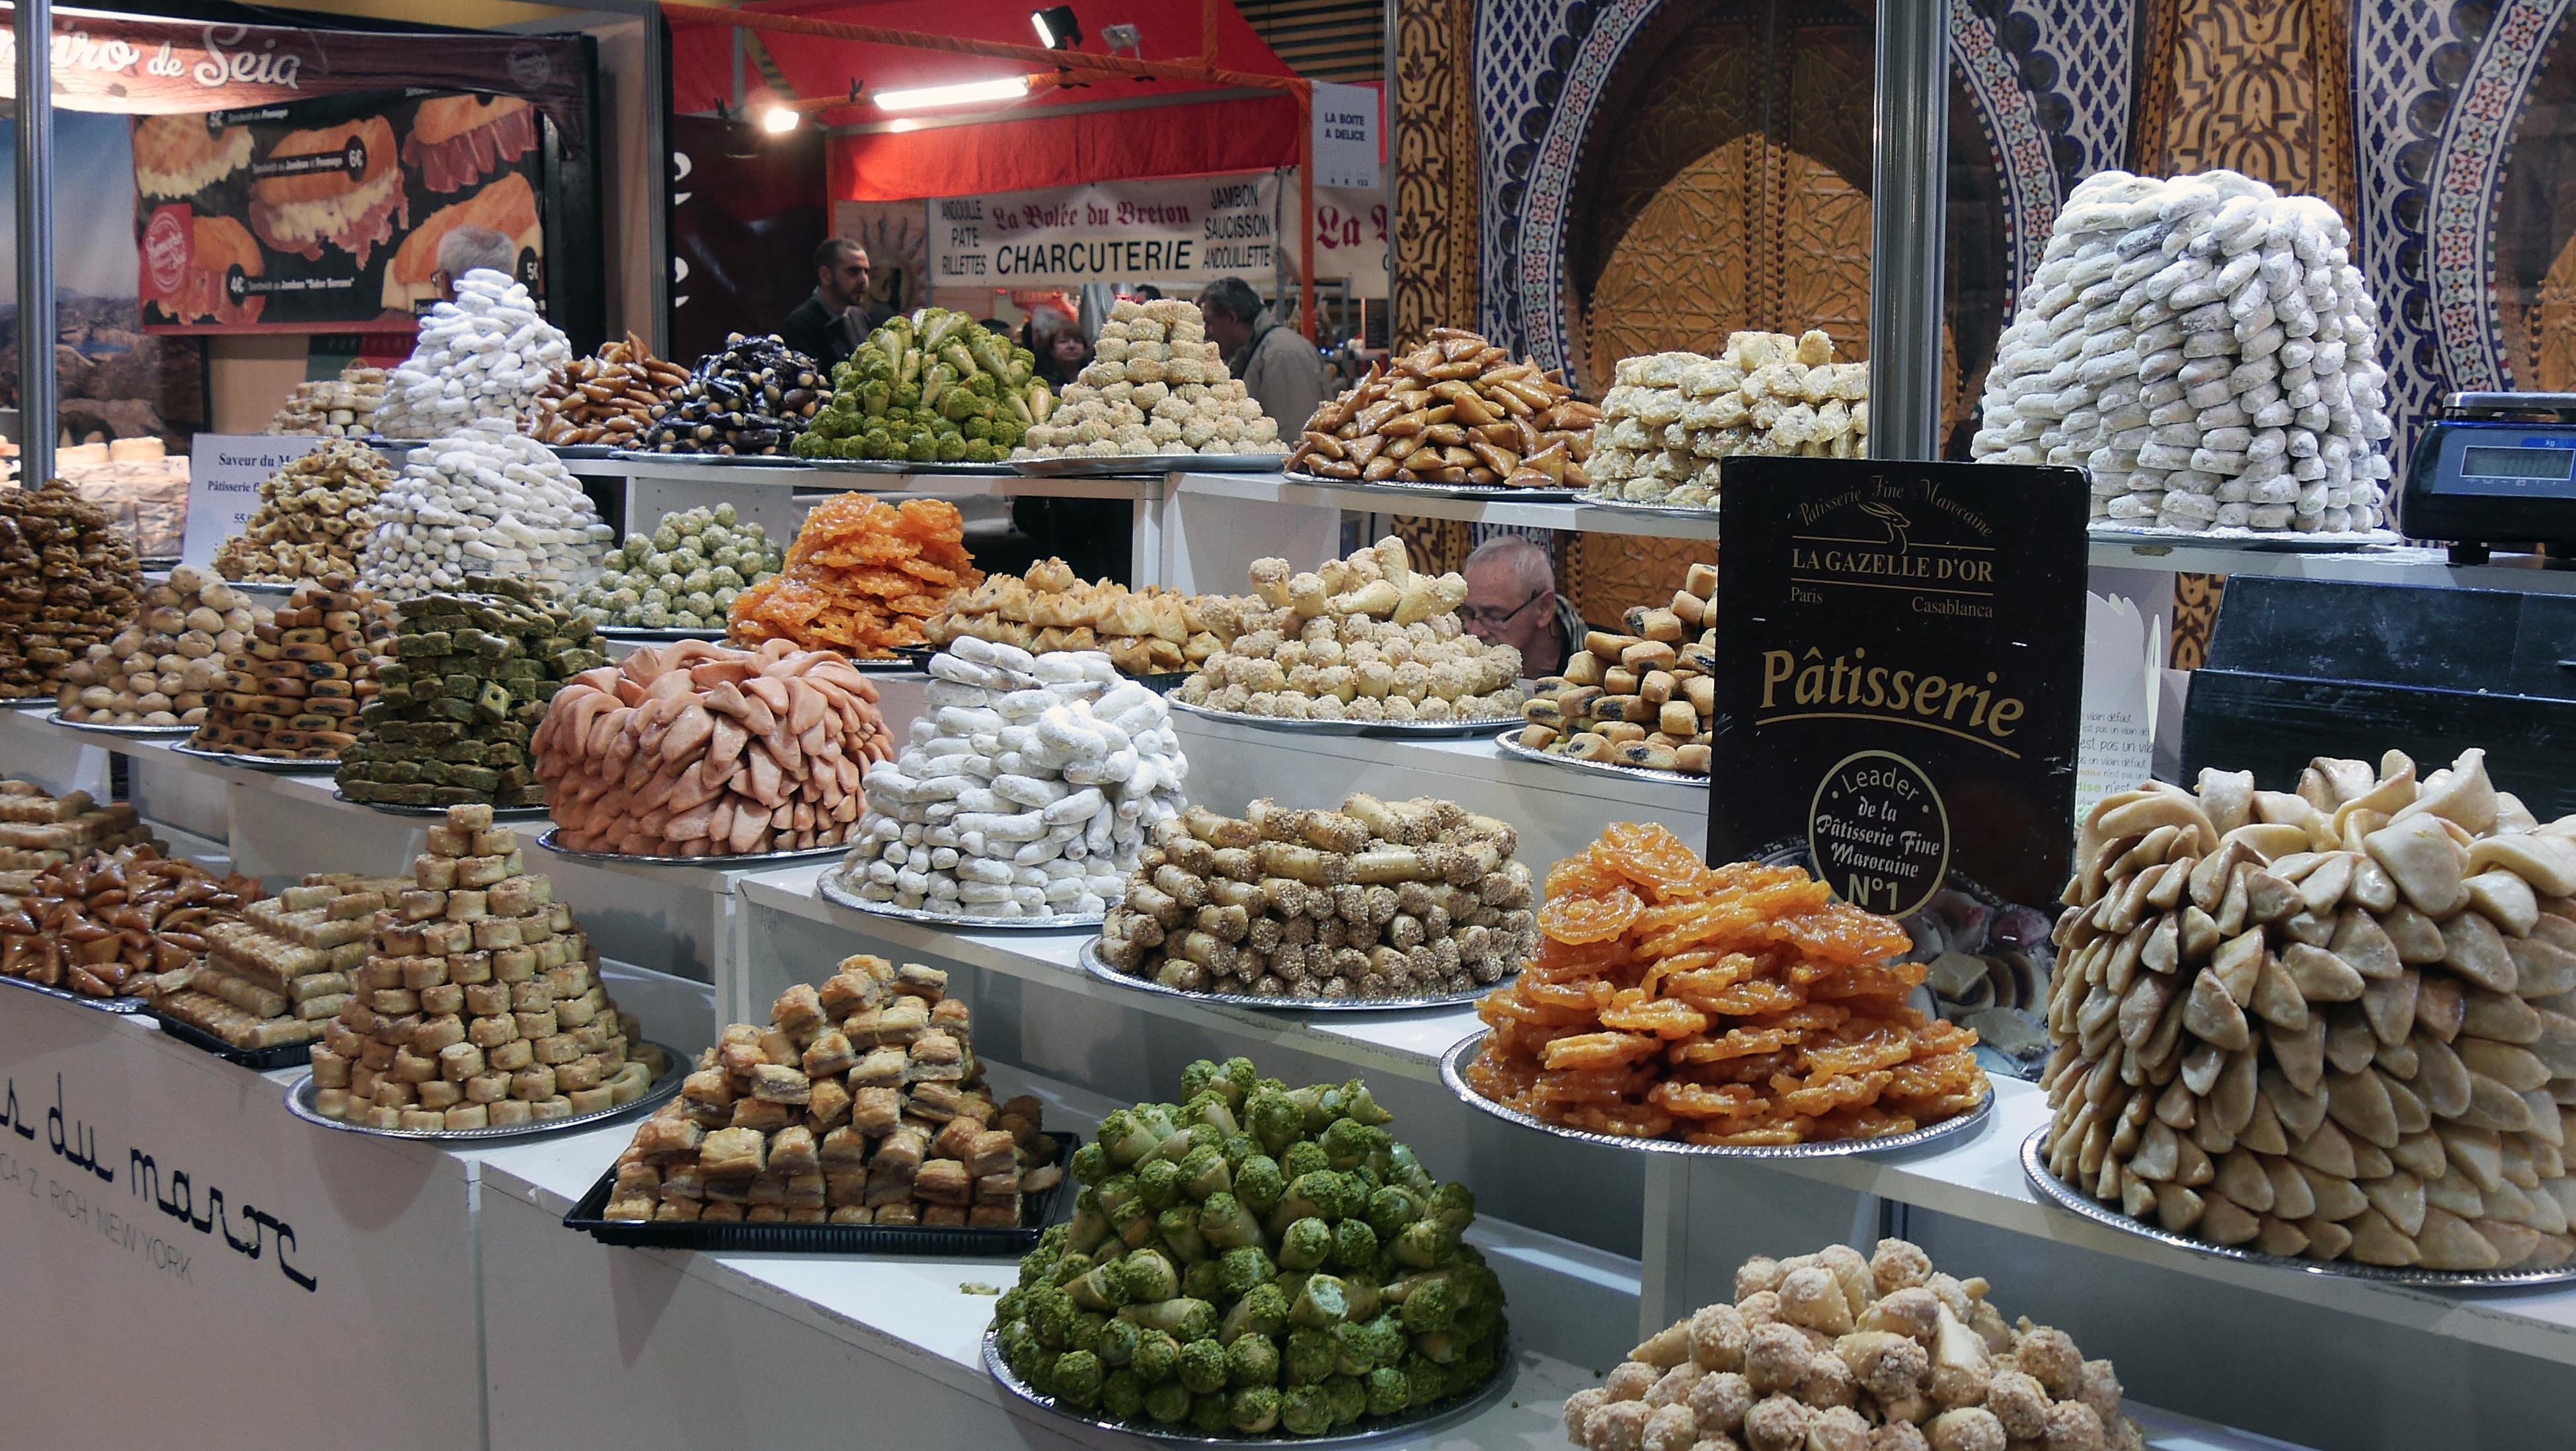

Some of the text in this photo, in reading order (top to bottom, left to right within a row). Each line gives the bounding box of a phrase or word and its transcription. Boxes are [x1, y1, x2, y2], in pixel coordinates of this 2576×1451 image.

[147, 41, 186, 78] de
[193, 21, 302, 90] Seia
[1325, 112, 1336, 123] LA
[1325, 128, 1332, 138] A
[1211, 184, 1259, 210] JAMBON
[993, 206, 1019, 231] La
[1087, 201, 1109, 225] du
[1117, 201, 1190, 225] Breton
[1205, 214, 1270, 241] SAUCISSON
[1317, 204, 1362, 249] La
[952, 227, 980, 247] PATE
[942, 254, 986, 275] RILLETTES
[997, 240, 1193, 274] CHARCUTERIE
[1202, 245, 1270, 270] ANDOUILLETTE
[219, 453, 257, 467] Saveur
[260, 453, 275, 467] du
[208, 481, 251, 492] Pâtisserie
[1871, 475, 1904, 499] Fine
[1920, 479, 1993, 537] Marocaine
[1792, 548, 1994, 582] LA GAZELLE D'OR
[1790, 586, 1823, 604] Paris
[1912, 596, 1993, 619] Casablanca
[1759, 645, 2025, 738] Pâtisserie
[2080, 736, 2154, 755] est pas un vila
[1842, 767, 1920, 801] Leader
[2077, 781, 2101, 793] dise
[1858, 795, 1897, 822] de la
[1816, 814, 1940, 856] Pâtisserie Fine
[1831, 842, 1920, 879] Marocaine
[48, 1072, 114, 1183] du
[130, 1146, 317, 1293] maroc
[140, 1230, 194, 1288] YORK
